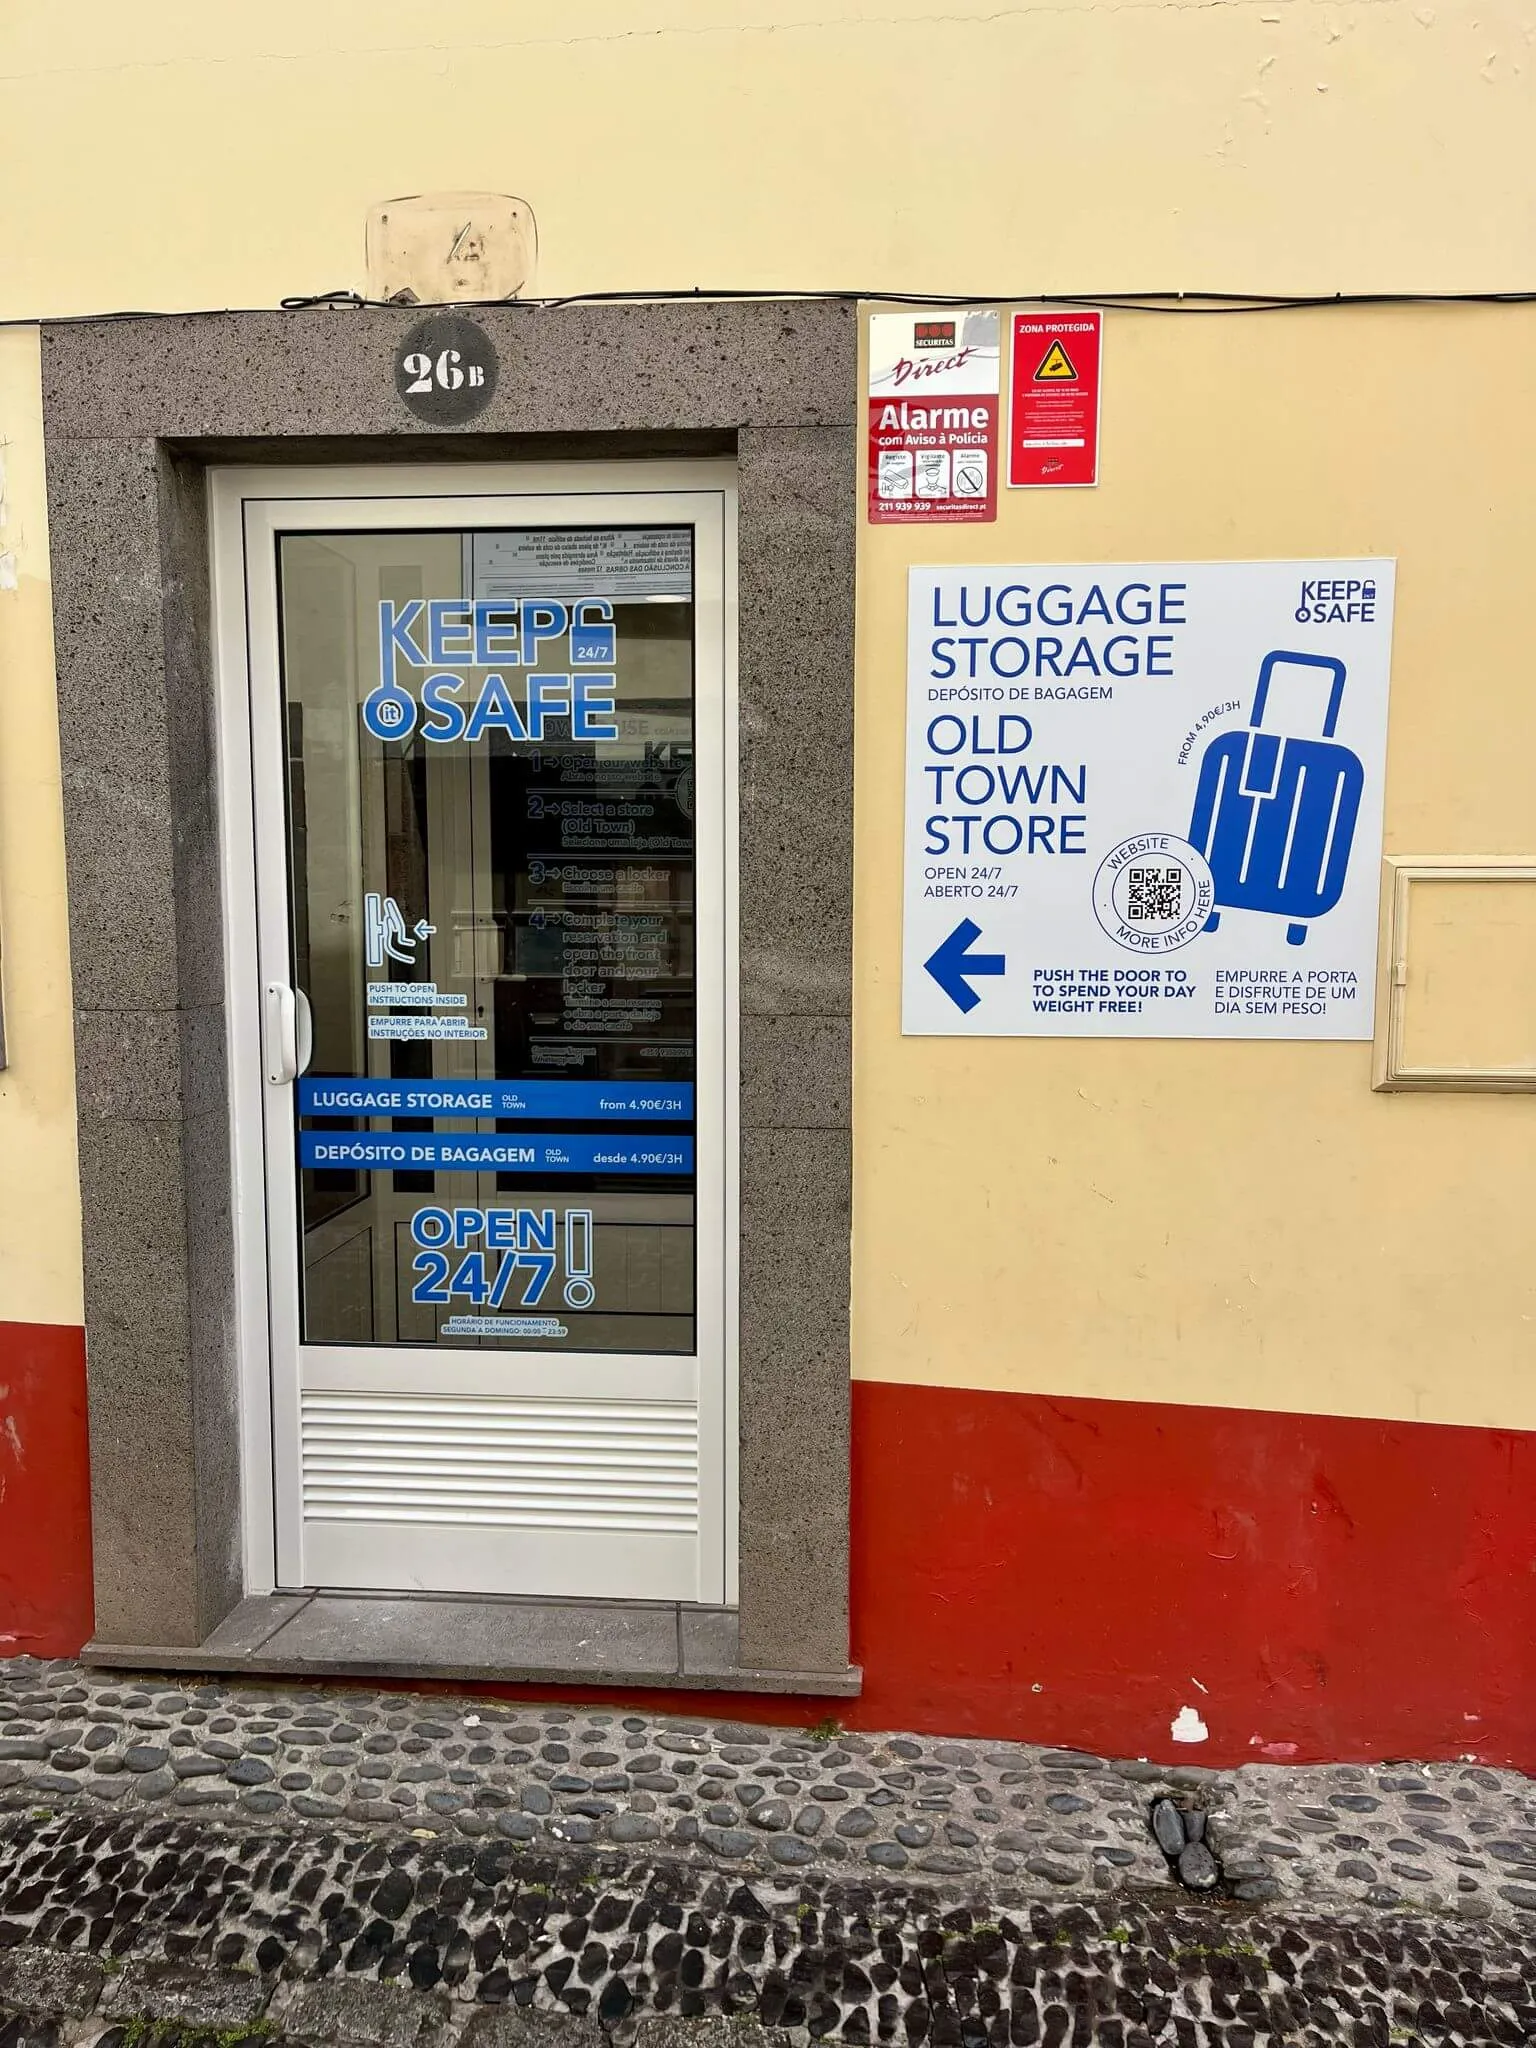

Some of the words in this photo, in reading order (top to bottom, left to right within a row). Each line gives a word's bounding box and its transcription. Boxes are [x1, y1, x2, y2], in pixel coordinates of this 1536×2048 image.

[1019, 324, 1044, 333] ZONA
[1046, 323, 1095, 332] PROTEGIDA
[915, 339, 954, 347] SECURITAS
[892, 346, 979, 386] Direct
[879, 401, 989, 430] Alarme
[879, 435, 902, 446] com
[905, 434, 936, 444] Aviso
[939, 432, 946, 444] à
[949, 432, 988, 444] Polícia
[879, 502, 894, 511] 211
[896, 502, 912, 511] 939
[914, 502, 931, 511] 939
[1301, 580, 1361, 600] KEEP
[933, 583, 1187, 627] LUGGAGE
[1313, 602, 1375, 624] SAFE
[378, 598, 568, 668] KEEP
[577, 645, 608, 660] 24/7
[929, 635, 1174, 679] STORAGE
[928, 686, 1005, 701] DEPÓSITO
[1009, 687, 1030, 700] DE
[1034, 687, 1113, 700] BAGAGEM
[420, 672, 618, 742] SAFE
[927, 714, 1033, 756] OLD
[1178, 731, 1198, 766] FROM
[1195, 700, 1241, 732] 4,90€/3H
[560, 754, 600, 772] Open
[924, 765, 1087, 806] TOWN
[528, 795, 545, 818] 2
[561, 800, 606, 817] Select
[607, 805, 617, 817] a
[617, 802, 655, 817] store
[561, 818, 593, 835] (Old
[593, 818, 636, 835] Town)
[924, 814, 1087, 856] STORE
[1107, 837, 1169, 870] WEBSITE
[528, 861, 546, 884] 3
[562, 865, 615, 882] Choose
[615, 869, 626, 882] a
[626, 866, 671, 882] locker
[924, 867, 967, 880] OPEN
[971, 866, 1002, 880] 24/7
[924, 885, 983, 898] ABERTO
[987, 885, 1018, 899] 24/7
[528, 907, 546, 930] 4
[561, 912, 631, 930] Complete
[630, 914, 664, 930] your
[1116, 925, 1160, 949] MORE
[1163, 920, 1198, 947] INFO
[1194, 879, 1211, 919] HERE
[562, 931, 640, 944] reservation
[640, 930, 668, 944] and
[563, 948, 599, 964] open
[599, 946, 625, 960] the
[625, 946, 661, 960] front
[563, 962, 597, 977] door
[598, 963, 625, 977] and
[1033, 969, 1074, 982] PUSH
[1079, 970, 1109, 982] THE
[1114, 970, 1161, 982] DOOR
[1165, 970, 1187, 982] TO
[1216, 970, 1288, 983] EMPURRE
[1292, 971, 1303, 983] A
[1308, 971, 1358, 983] PORTA
[369, 985, 392, 993] PUSH
[395, 985, 407, 993] TO
[409, 985, 435, 993] OPEN
[562, 981, 606, 995] locker
[1033, 985, 1054, 997] TO
[1059, 985, 1111, 997] SPEND
[1115, 985, 1159, 998] YOUR
[1164, 986, 1197, 998] DAY
[1215, 986, 1224, 998] E
[1229, 986, 1301, 998] DISFRUTE
[1305, 986, 1327, 999] DE
[1331, 987, 1356, 999] UM
[369, 996, 433, 1004] INSTRUCTIONS
[436, 996, 465, 1004] INSIDE
[1033, 1001, 1094, 1013] WEIGHT
[1099, 1001, 1142, 1013] FREE!
[1215, 1002, 1241, 1014] DIA
[1245, 1002, 1277, 1014] SEM
[1282, 1002, 1326, 1015] PESO!
[370, 1018, 411, 1026] EMPURRE
[414, 1018, 437, 1026] PARA
[440, 1018, 466, 1026] ABRIR
[370, 1028, 425, 1039] INSTRUÇÕES
[444, 1030, 486, 1038] INTERIOR
[313, 1092, 401, 1108] LUGGAGE
[407, 1093, 492, 1109] STORAGE
[600, 1098, 626, 1111] from
[629, 1099, 682, 1111] 4.90€/3H
[314, 1143, 405, 1161] DEPÓSITO
[411, 1146, 435, 1161] DE
[442, 1146, 535, 1163] BAGAGEM
[593, 1152, 627, 1164] desde
[630, 1153, 683, 1165] 4.90€/3H
[411, 1206, 556, 1251] OPEN
[411, 1251, 556, 1309] 24/7
[495, 1319, 558, 1327] FUNCIONAMENTO
